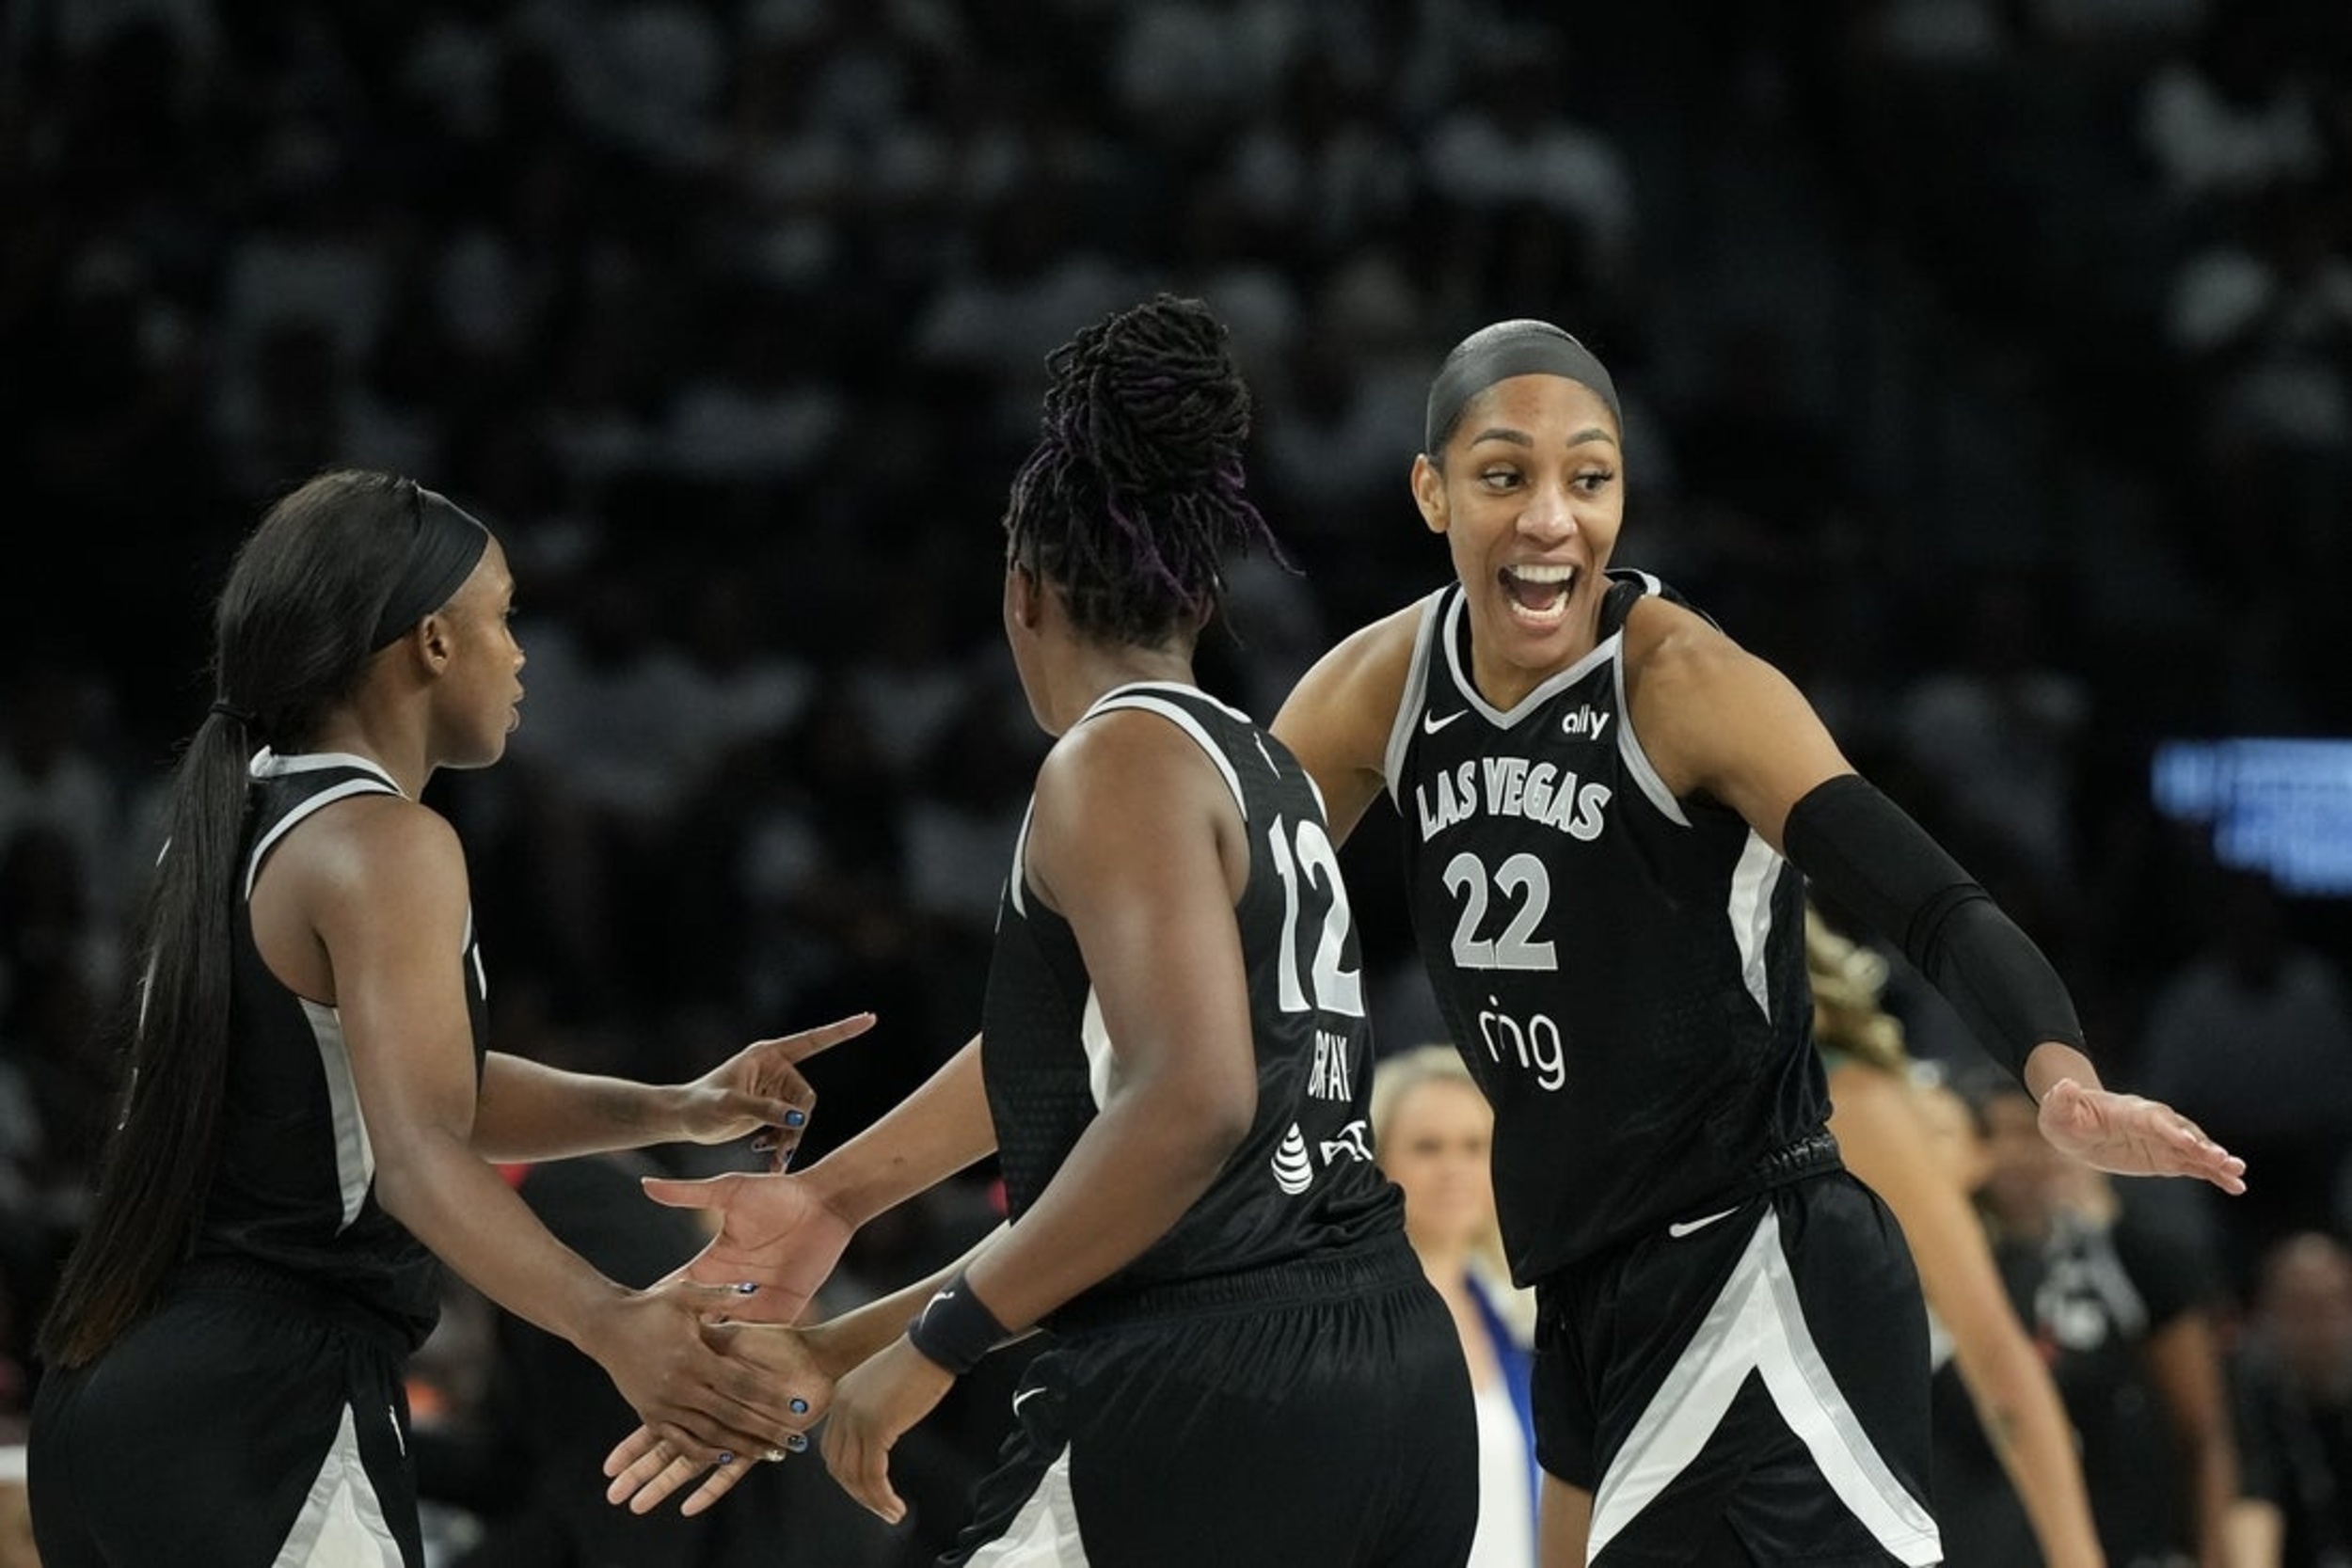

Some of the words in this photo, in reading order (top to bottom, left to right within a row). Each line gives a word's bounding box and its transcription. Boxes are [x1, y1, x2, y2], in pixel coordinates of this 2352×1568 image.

[1562, 704, 1610, 740] ally
[1416, 760, 1477, 842] LAS
[1482, 756, 1612, 841] VEGAS
[1268, 814, 1365, 1017] 12
[1442, 852, 1558, 971] 22
[1479, 994, 1565, 1091] ring
